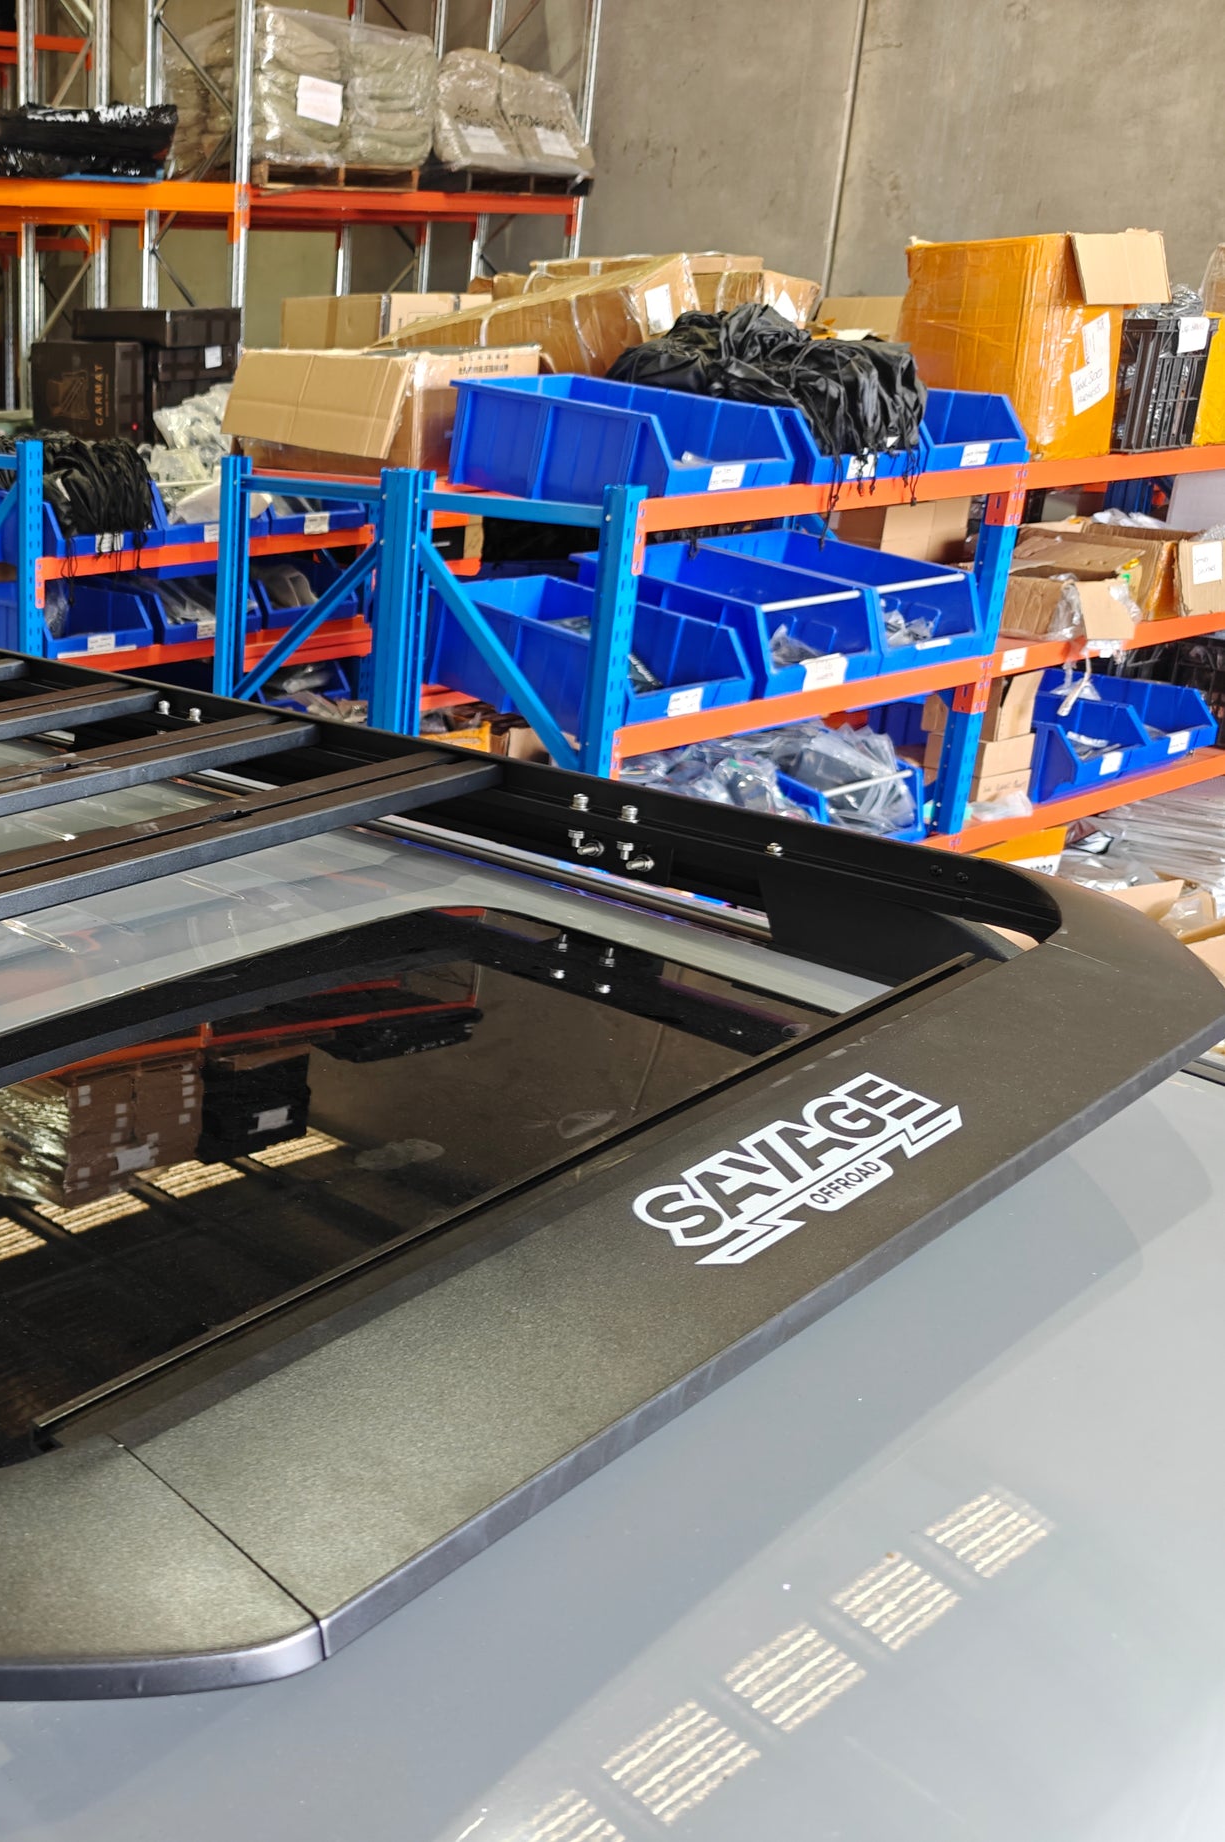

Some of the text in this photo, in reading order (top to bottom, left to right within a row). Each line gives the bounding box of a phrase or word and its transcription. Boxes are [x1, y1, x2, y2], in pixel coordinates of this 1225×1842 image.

[94, 364, 104, 426] CARMAT
[633, 1072, 945, 1246] SAVAGE
[809, 1160, 881, 1205] OFFROAD
